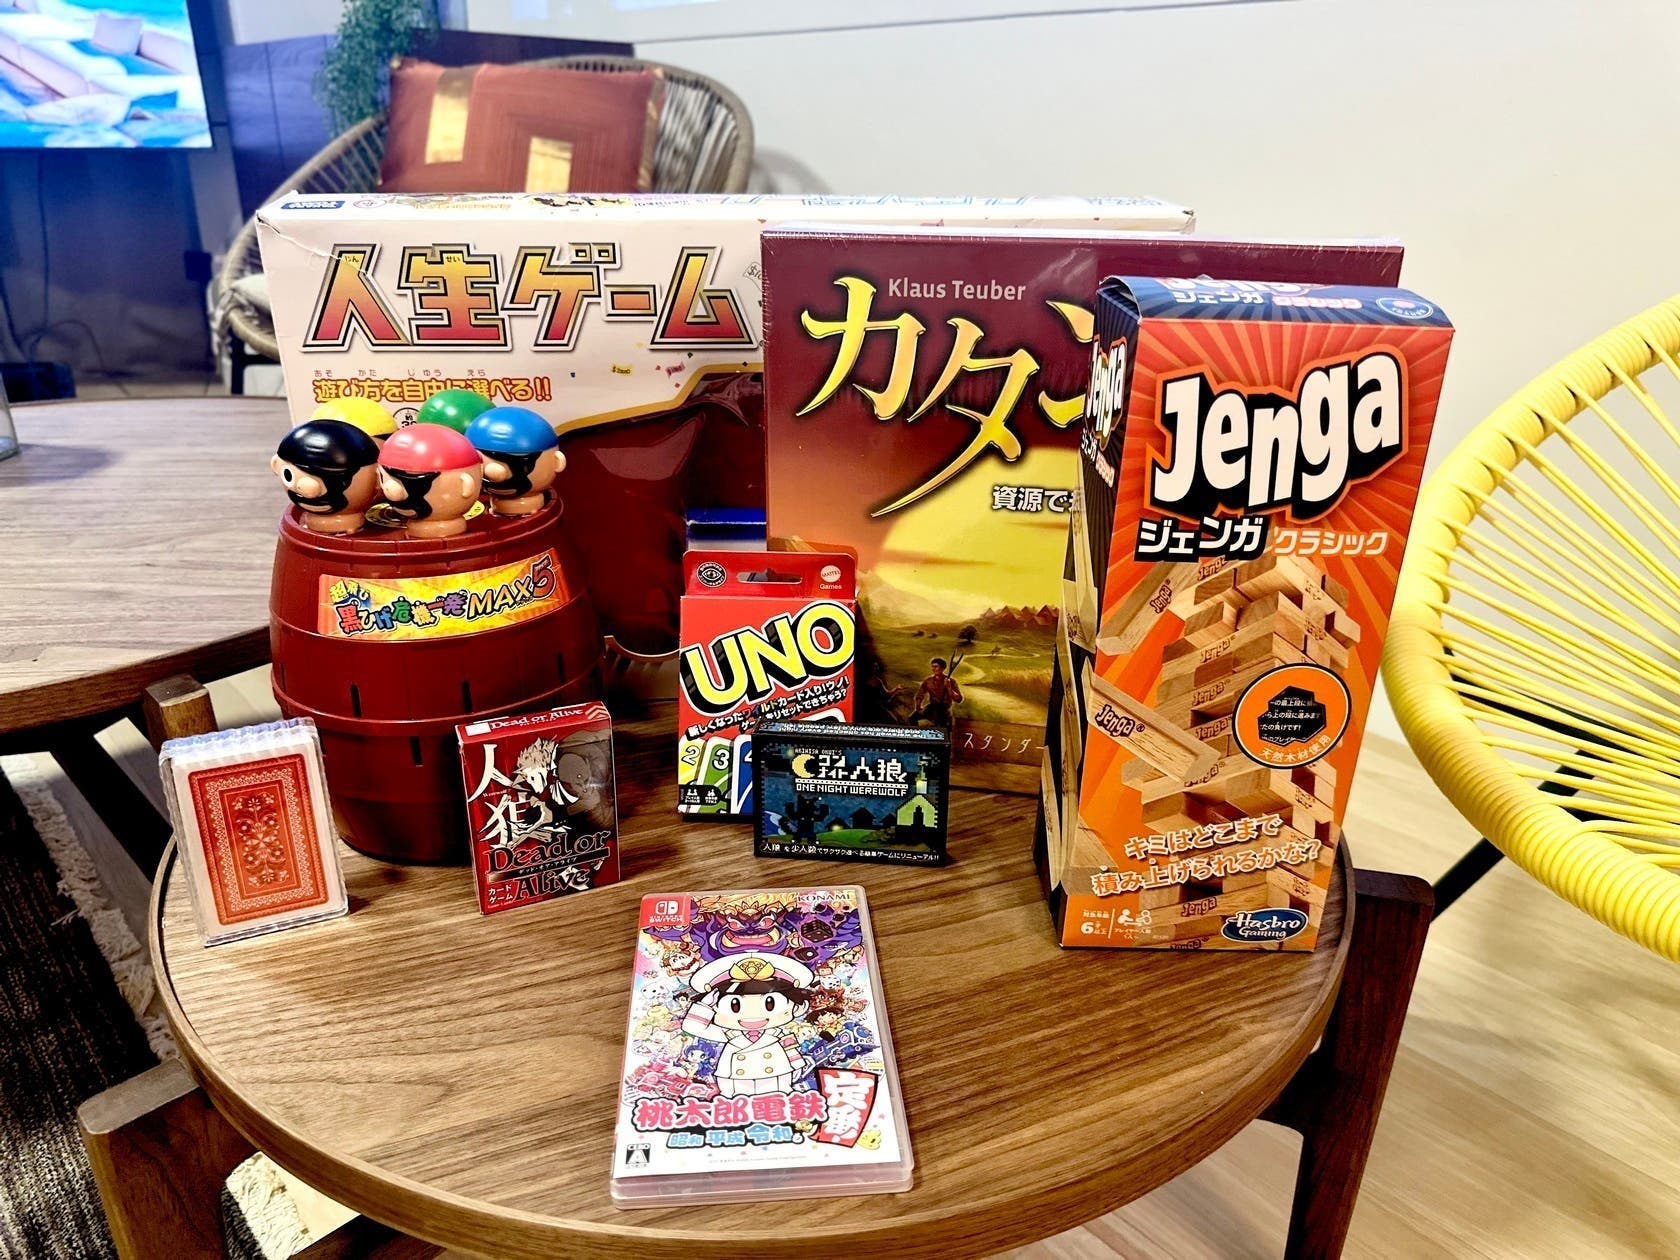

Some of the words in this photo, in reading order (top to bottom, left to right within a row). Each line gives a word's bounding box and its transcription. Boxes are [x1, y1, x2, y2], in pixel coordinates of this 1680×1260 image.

[304, 243, 757, 350] 人生ゲーム
[888, 278, 946, 299] Klaus
[952, 279, 1026, 301] Teuber
[1151, 350, 1403, 512] Jenga
[992, 485, 1074, 513] 資源で
[1137, 515, 1265, 555] ジェンガ
[1274, 527, 1388, 556] クラシック
[336, 590, 468, 635] 黒ひげ危機一発
[467, 554, 557, 619] MAX5
[681, 602, 856, 712] UNO
[490, 717, 529, 729] Dead
[531, 715, 548, 723] or
[549, 709, 583, 719] Alive
[682, 745, 700, 765] 2
[712, 749, 730, 770] 3
[850, 757, 908, 783] 人狼
[796, 783, 816, 792] ONE
[817, 784, 848, 794] NIGHT
[850, 787, 908, 797] WEREWOLF
[1123, 813, 1284, 860] キミはどこまで
[483, 832, 573, 875] Dead
[574, 830, 611, 854] or
[1090, 839, 1323, 897] 積み上げられるかな?
[488, 884, 513, 896] カード
[514, 868, 591, 902] Alive
[489, 893, 514, 905] ゲーム
[1080, 922, 1094, 935] 6
[1228, 913, 1300, 931] Hasbro
[1239, 927, 1287, 938] Gaming
[633, 1091, 827, 1131] 桃太郎電鉄
[667, 1132, 704, 1147] 昭和
[706, 1130, 745, 1146] 平成
[746, 1124, 793, 1144] 令和
